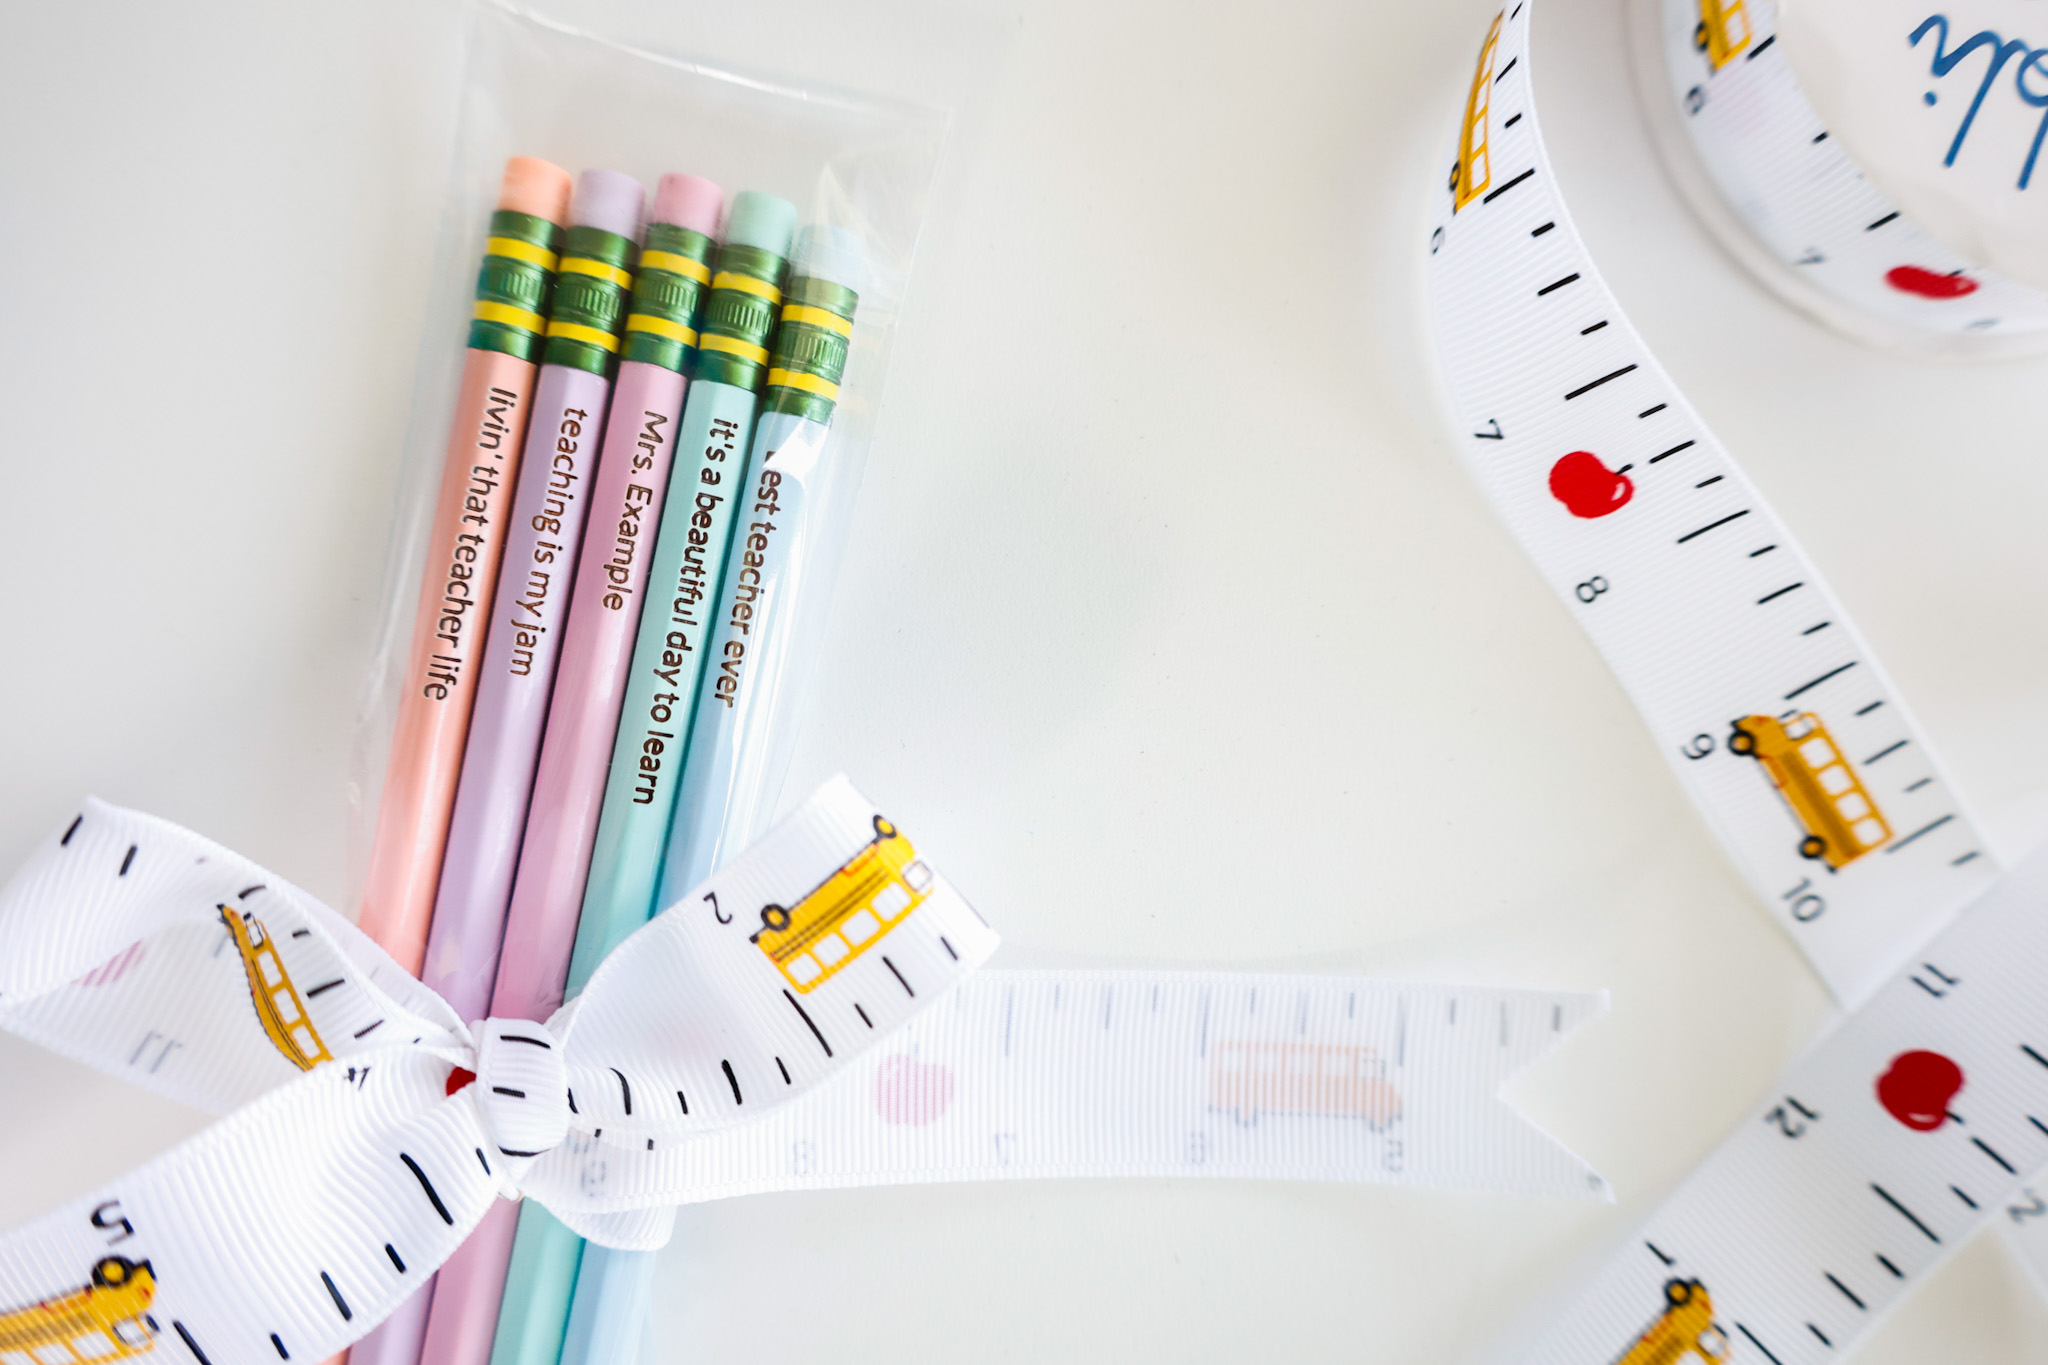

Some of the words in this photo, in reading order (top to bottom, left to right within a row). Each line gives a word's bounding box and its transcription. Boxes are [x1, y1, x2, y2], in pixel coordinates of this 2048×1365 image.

[478, 386, 518, 460] livin'
[630, 410, 669, 475] Mrs.
[704, 417, 739, 463] it's
[1473, 418, 1505, 441] 7
[531, 407, 589, 536] teaching
[700, 467, 722, 486] a
[753, 450, 783, 516] est
[462, 465, 500, 528] that
[533, 540, 564, 565] is
[602, 483, 654, 611] Example
[671, 491, 725, 627] beautiful
[436, 533, 486, 649] teacher
[515, 570, 551, 619] my
[729, 521, 778, 636] teacher
[1575, 575, 1609, 604] 8
[509, 618, 547, 677] jam
[652, 630, 693, 688] day
[423, 654, 463, 701] life
[713, 640, 746, 709] ever
[649, 692, 681, 724] to
[632, 729, 675, 805] learn
[1682, 733, 1715, 761] 9
[702, 891, 733, 925] 2
[1782, 877, 1827, 923] 10
[1909, 962, 1960, 999] 11
[1765, 1096, 1820, 1139] 12
[89, 1200, 135, 1244] 5
